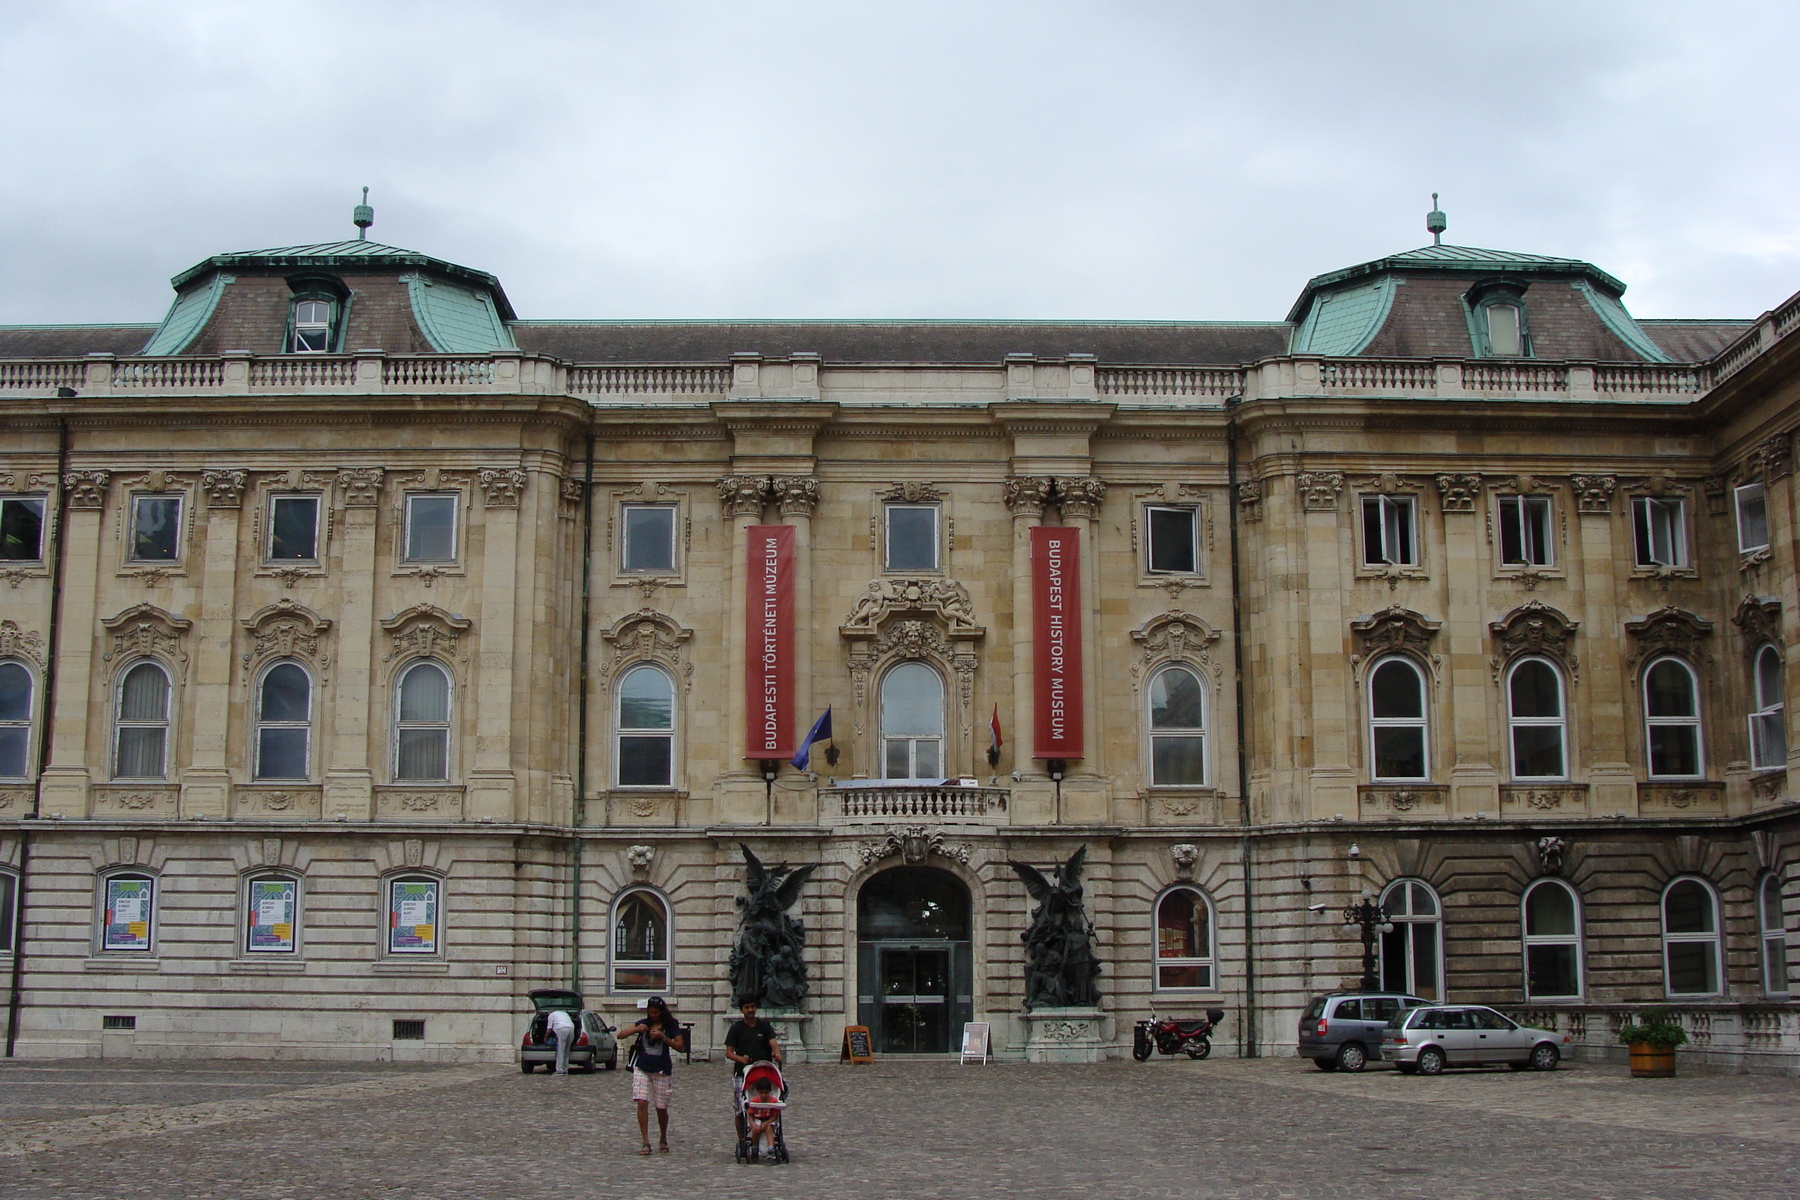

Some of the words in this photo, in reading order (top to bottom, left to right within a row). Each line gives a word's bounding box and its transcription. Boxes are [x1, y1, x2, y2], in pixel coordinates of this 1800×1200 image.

[763, 538, 777, 595] MÚZEUM
[1049, 539, 1062, 611] BUDAPEST
[762, 598, 777, 672] TÖRTÉNETI
[1050, 615, 1064, 674] HISTORY
[765, 675, 777, 750] BUDAPESTI
[1051, 678, 1064, 740] MUSEUM
